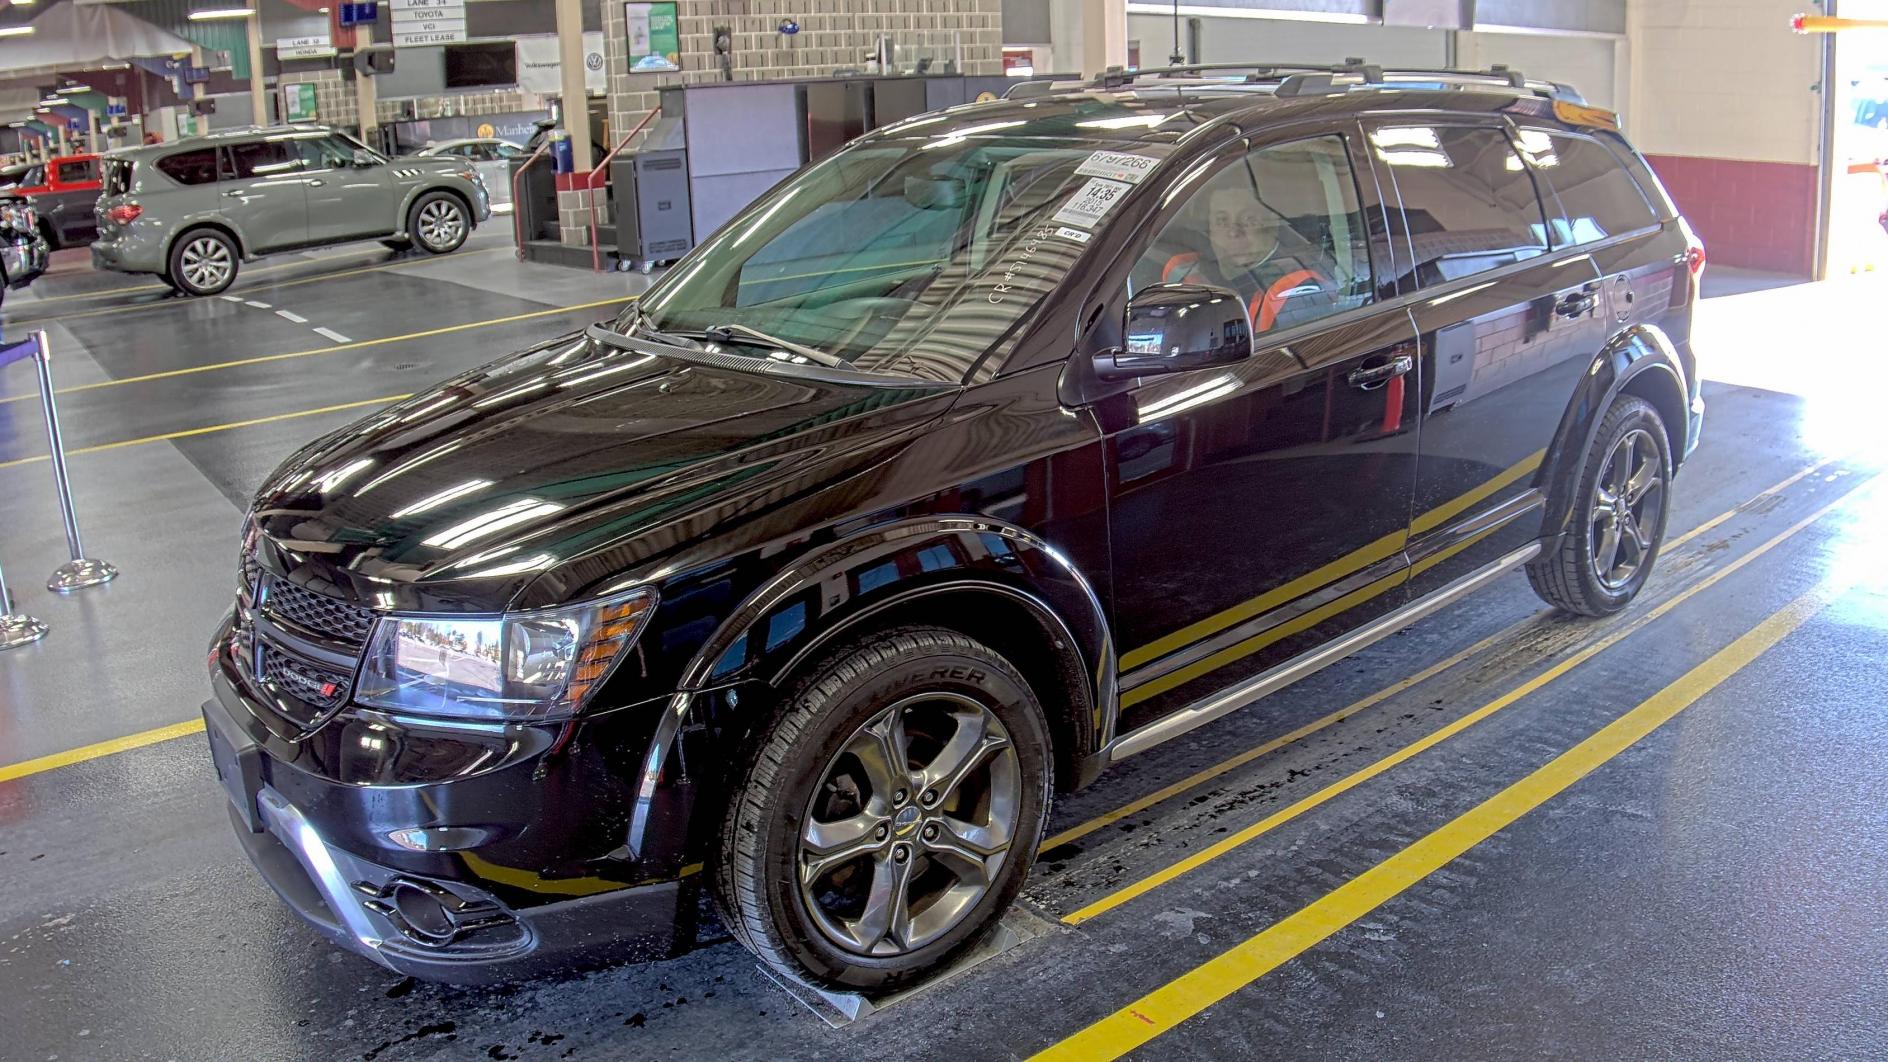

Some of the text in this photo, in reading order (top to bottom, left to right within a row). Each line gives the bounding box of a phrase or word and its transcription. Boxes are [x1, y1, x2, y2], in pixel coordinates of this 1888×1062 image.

[414, 10, 443, 19] TOYOTA
[404, 33, 455, 43] FLEET LEASE
